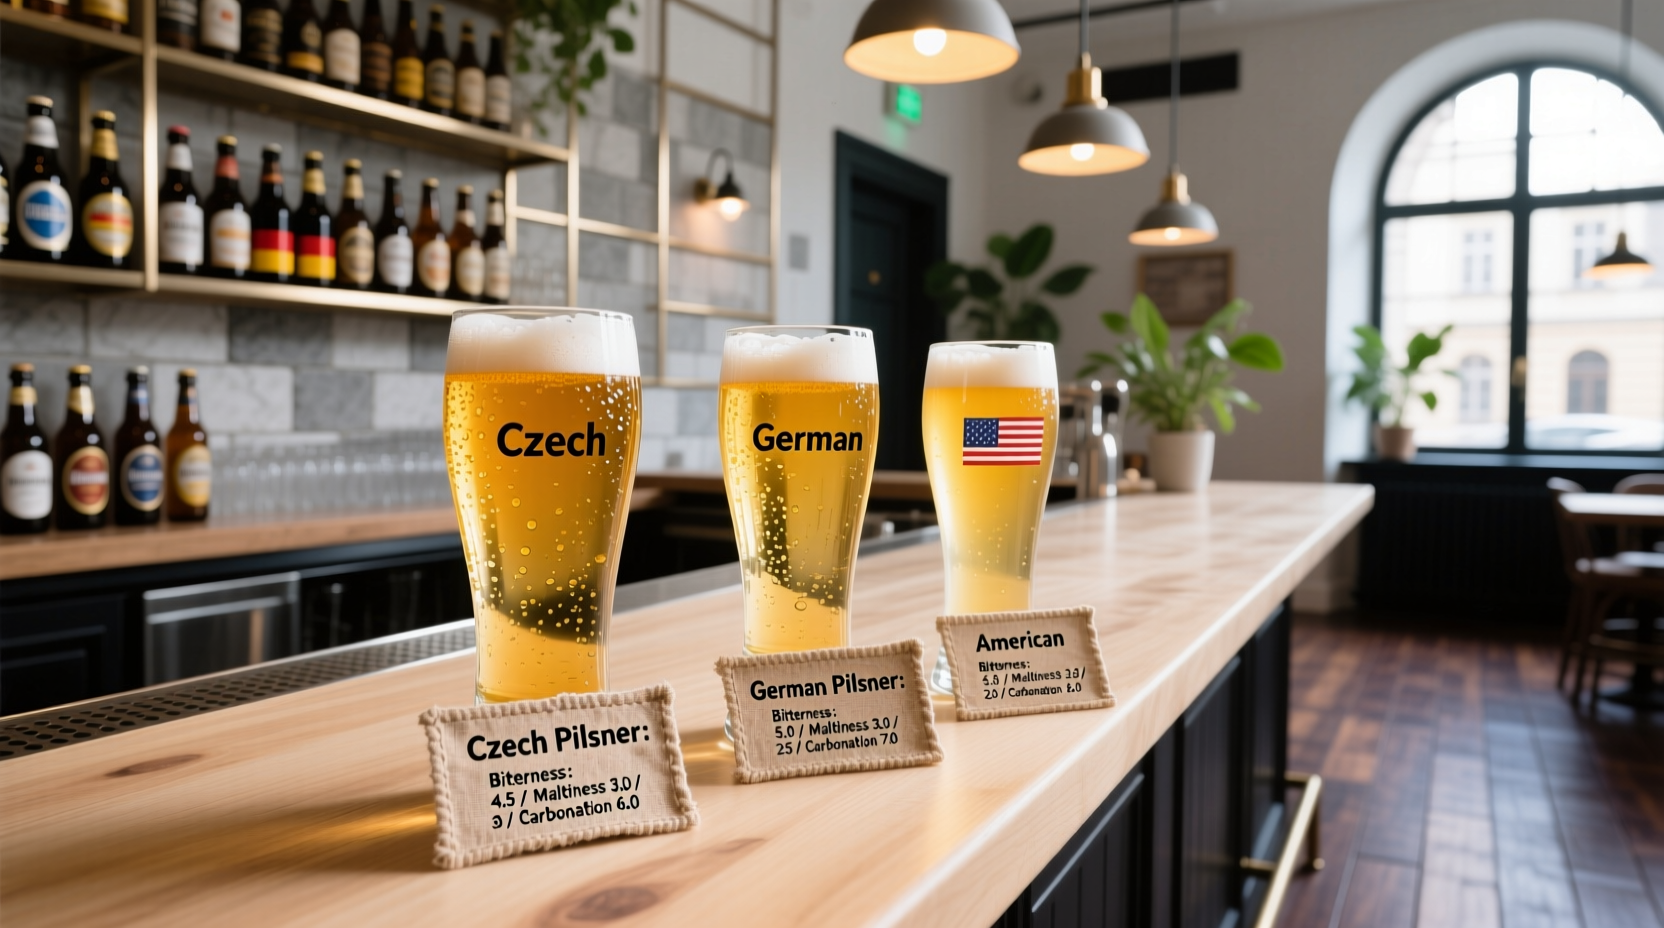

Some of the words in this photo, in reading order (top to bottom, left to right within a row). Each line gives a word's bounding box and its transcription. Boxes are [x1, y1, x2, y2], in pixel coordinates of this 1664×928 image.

[497, 421, 606, 457] Czech
[752, 422, 863, 452] German
[976, 630, 1065, 652] American
[750, 679, 827, 700] German
[831, 672, 905, 694] Pilsner:
[467, 729, 548, 761] Czech
[554, 724, 650, 752] Pilsner:
[775, 725, 795, 739] 5.0
[491, 791, 516, 809] 4.5
[533, 781, 606, 804] Maltiness
[610, 776, 631, 793] 3.0
[519, 800, 612, 826] Carbonation
[616, 794, 640, 811] 6.0
